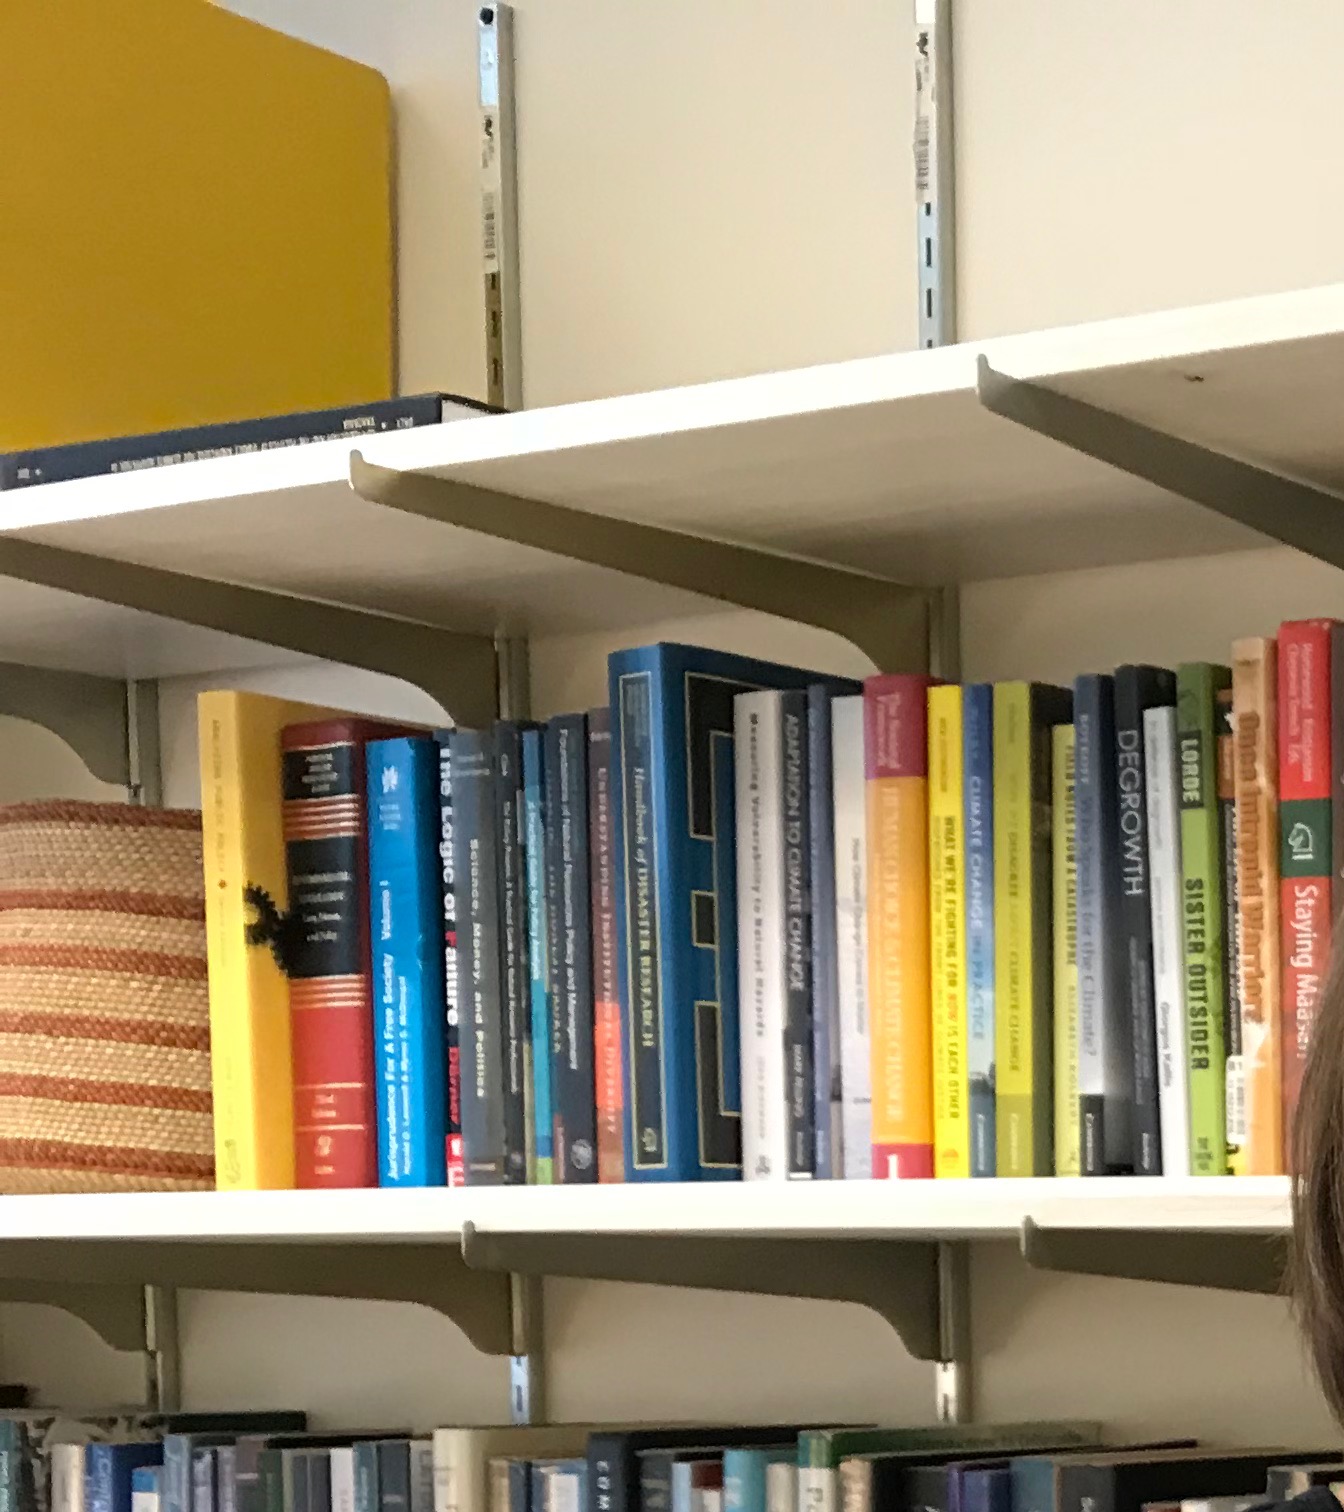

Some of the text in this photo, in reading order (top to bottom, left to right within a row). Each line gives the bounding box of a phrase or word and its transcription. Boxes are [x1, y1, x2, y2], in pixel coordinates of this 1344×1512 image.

[1117, 728, 1144, 897] DEGROWTH
[1180, 738, 1200, 802] LORDE
[439, 806, 461, 1025] Logic of Failure
[637, 866, 656, 1047] DISASTER RESEARCH
[1184, 878, 1211, 1071] SISTER OUTSIDER
[1290, 883, 1319, 969] Staying
